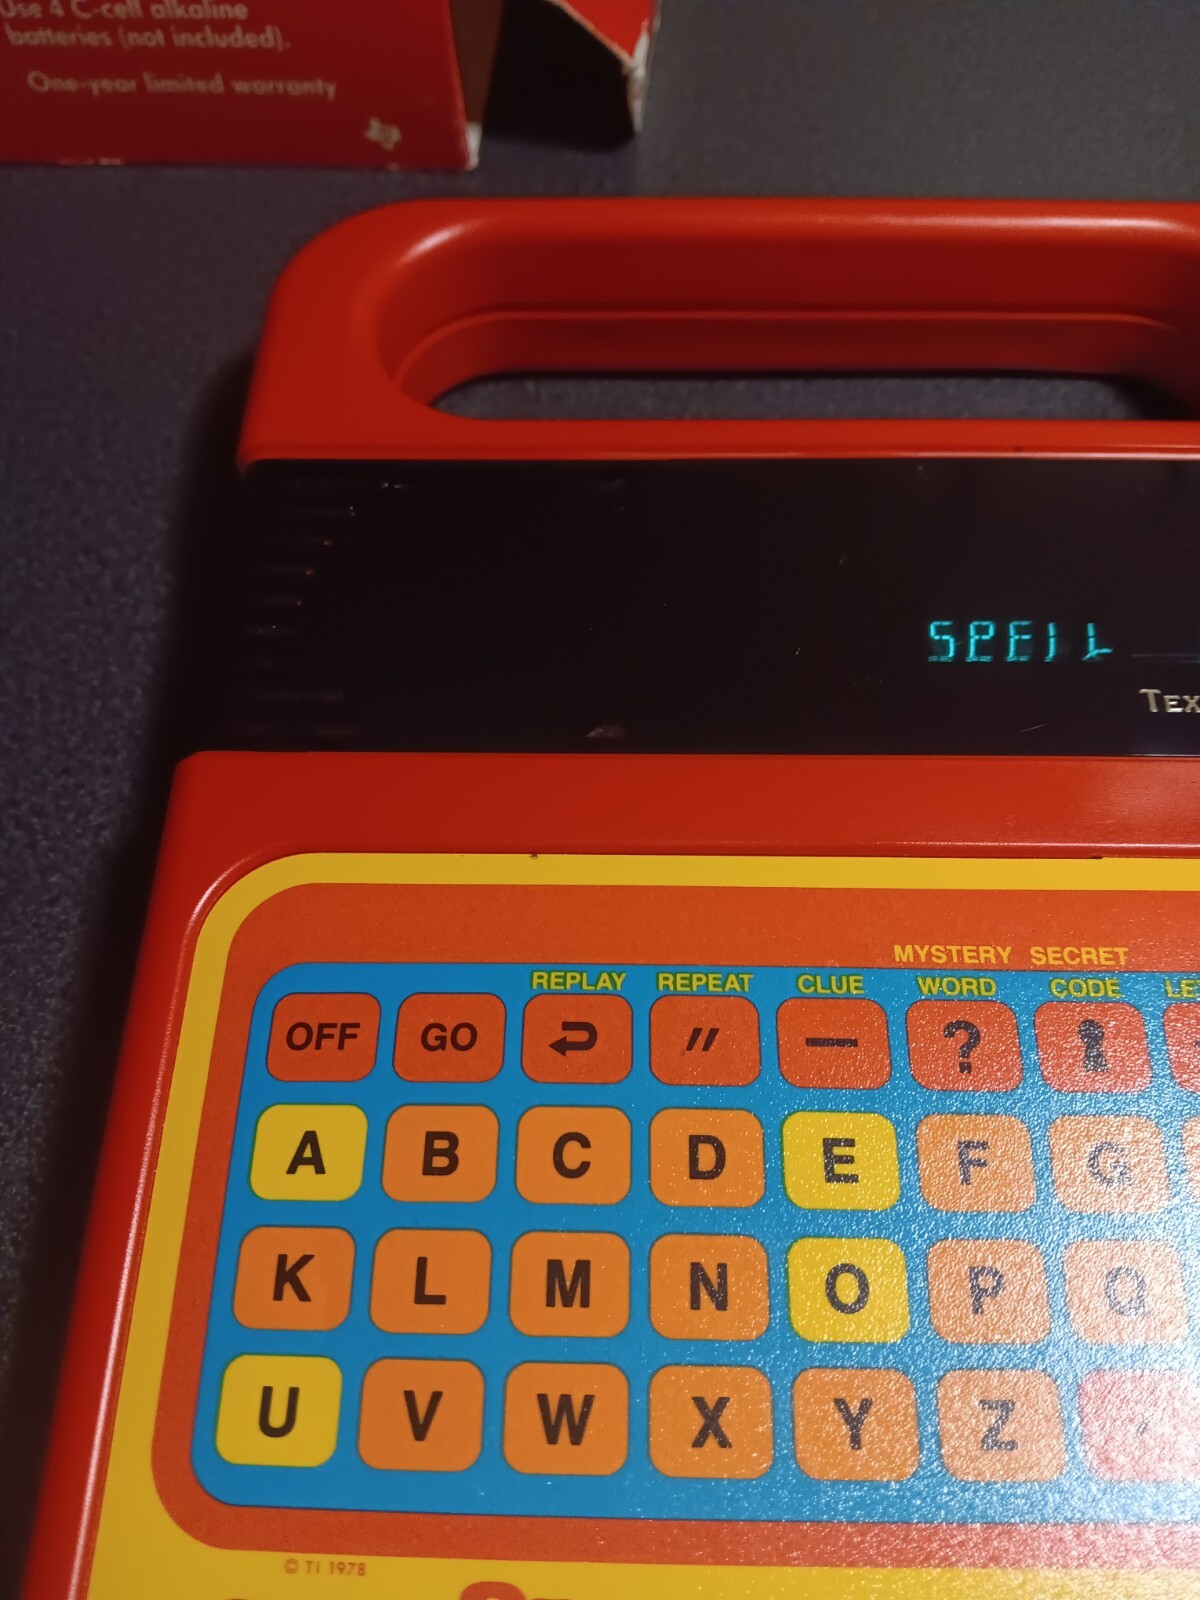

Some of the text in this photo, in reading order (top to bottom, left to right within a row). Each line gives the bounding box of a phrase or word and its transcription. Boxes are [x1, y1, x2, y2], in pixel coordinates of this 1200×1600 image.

[0, 0, 43, 19] Use
[70, 0, 144, 19] C-cell
[150, 0, 249, 20] alkaline
[4, 22, 292, 52] batteries (not included).
[27, 71, 336, 102] One-year limited warranty
[893, 944, 1012, 965] MYSTERY
[1030, 946, 1129, 966] SECRET
[530, 971, 627, 991] REPLAY
[657, 972, 753, 993] REPEAT
[797, 974, 865, 995] CLUE
[917, 976, 997, 997] WORD
[1050, 978, 1123, 998] CODE
[286, 1021, 361, 1051] OFF
[420, 1022, 478, 1052] GO
[285, 1130, 326, 1175] A
[422, 1130, 460, 1177] B
[552, 1131, 592, 1179] C
[687, 1134, 726, 1180] D
[822, 1137, 859, 1184] E
[957, 1140, 990, 1186] F
[272, 1253, 316, 1303] K
[413, 1256, 447, 1305] L
[545, 1258, 591, 1308] M
[689, 1261, 728, 1311] N
[825, 1263, 870, 1315] O
[969, 1266, 1005, 1315] P
[258, 1385, 1019, 1452] U V W X Y Z
[304, 1560, 321, 1575] TI
[328, 1561, 367, 1577] 1978
